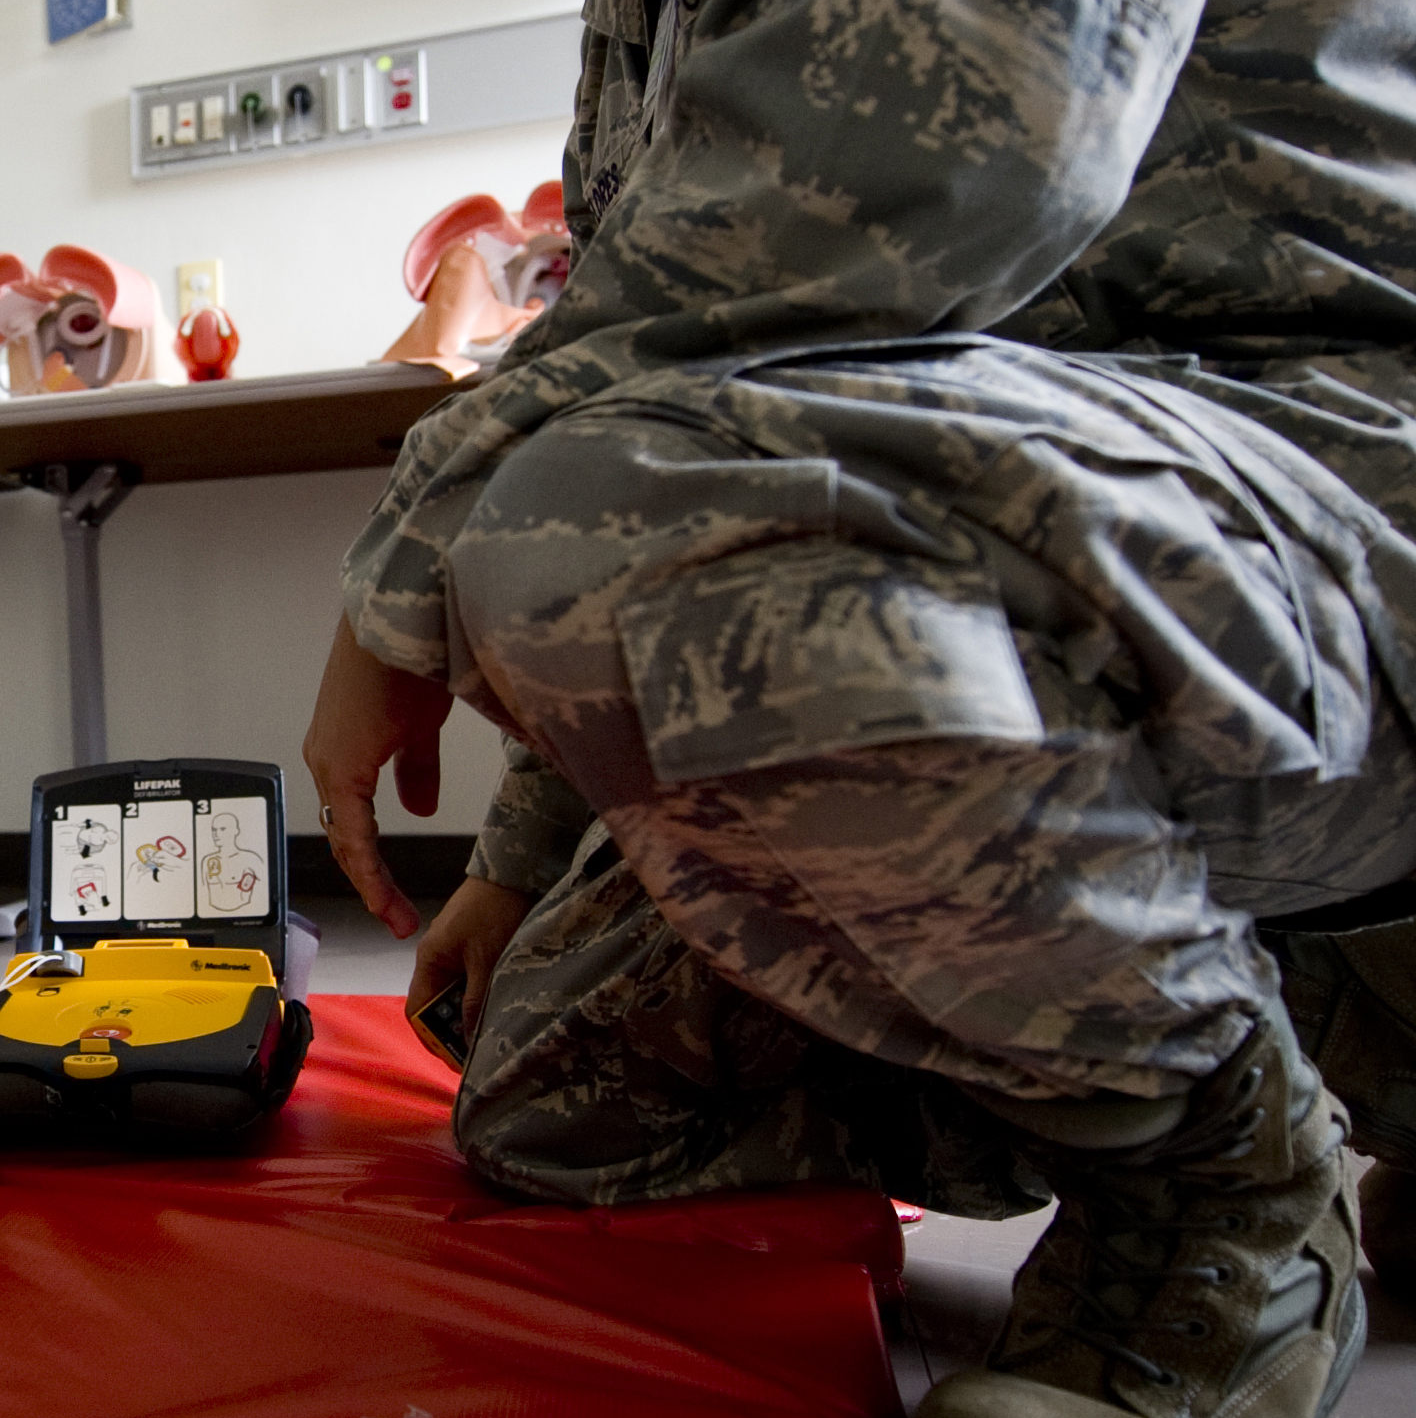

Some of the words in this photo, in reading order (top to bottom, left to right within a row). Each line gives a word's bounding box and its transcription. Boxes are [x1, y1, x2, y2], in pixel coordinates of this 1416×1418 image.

[134, 779, 181, 790] LIFEPAK
[55, 806, 65, 819] 1
[125, 803, 137, 816] 2
[197, 800, 209, 813] 3
[205, 962, 251, 971] Medtronic
